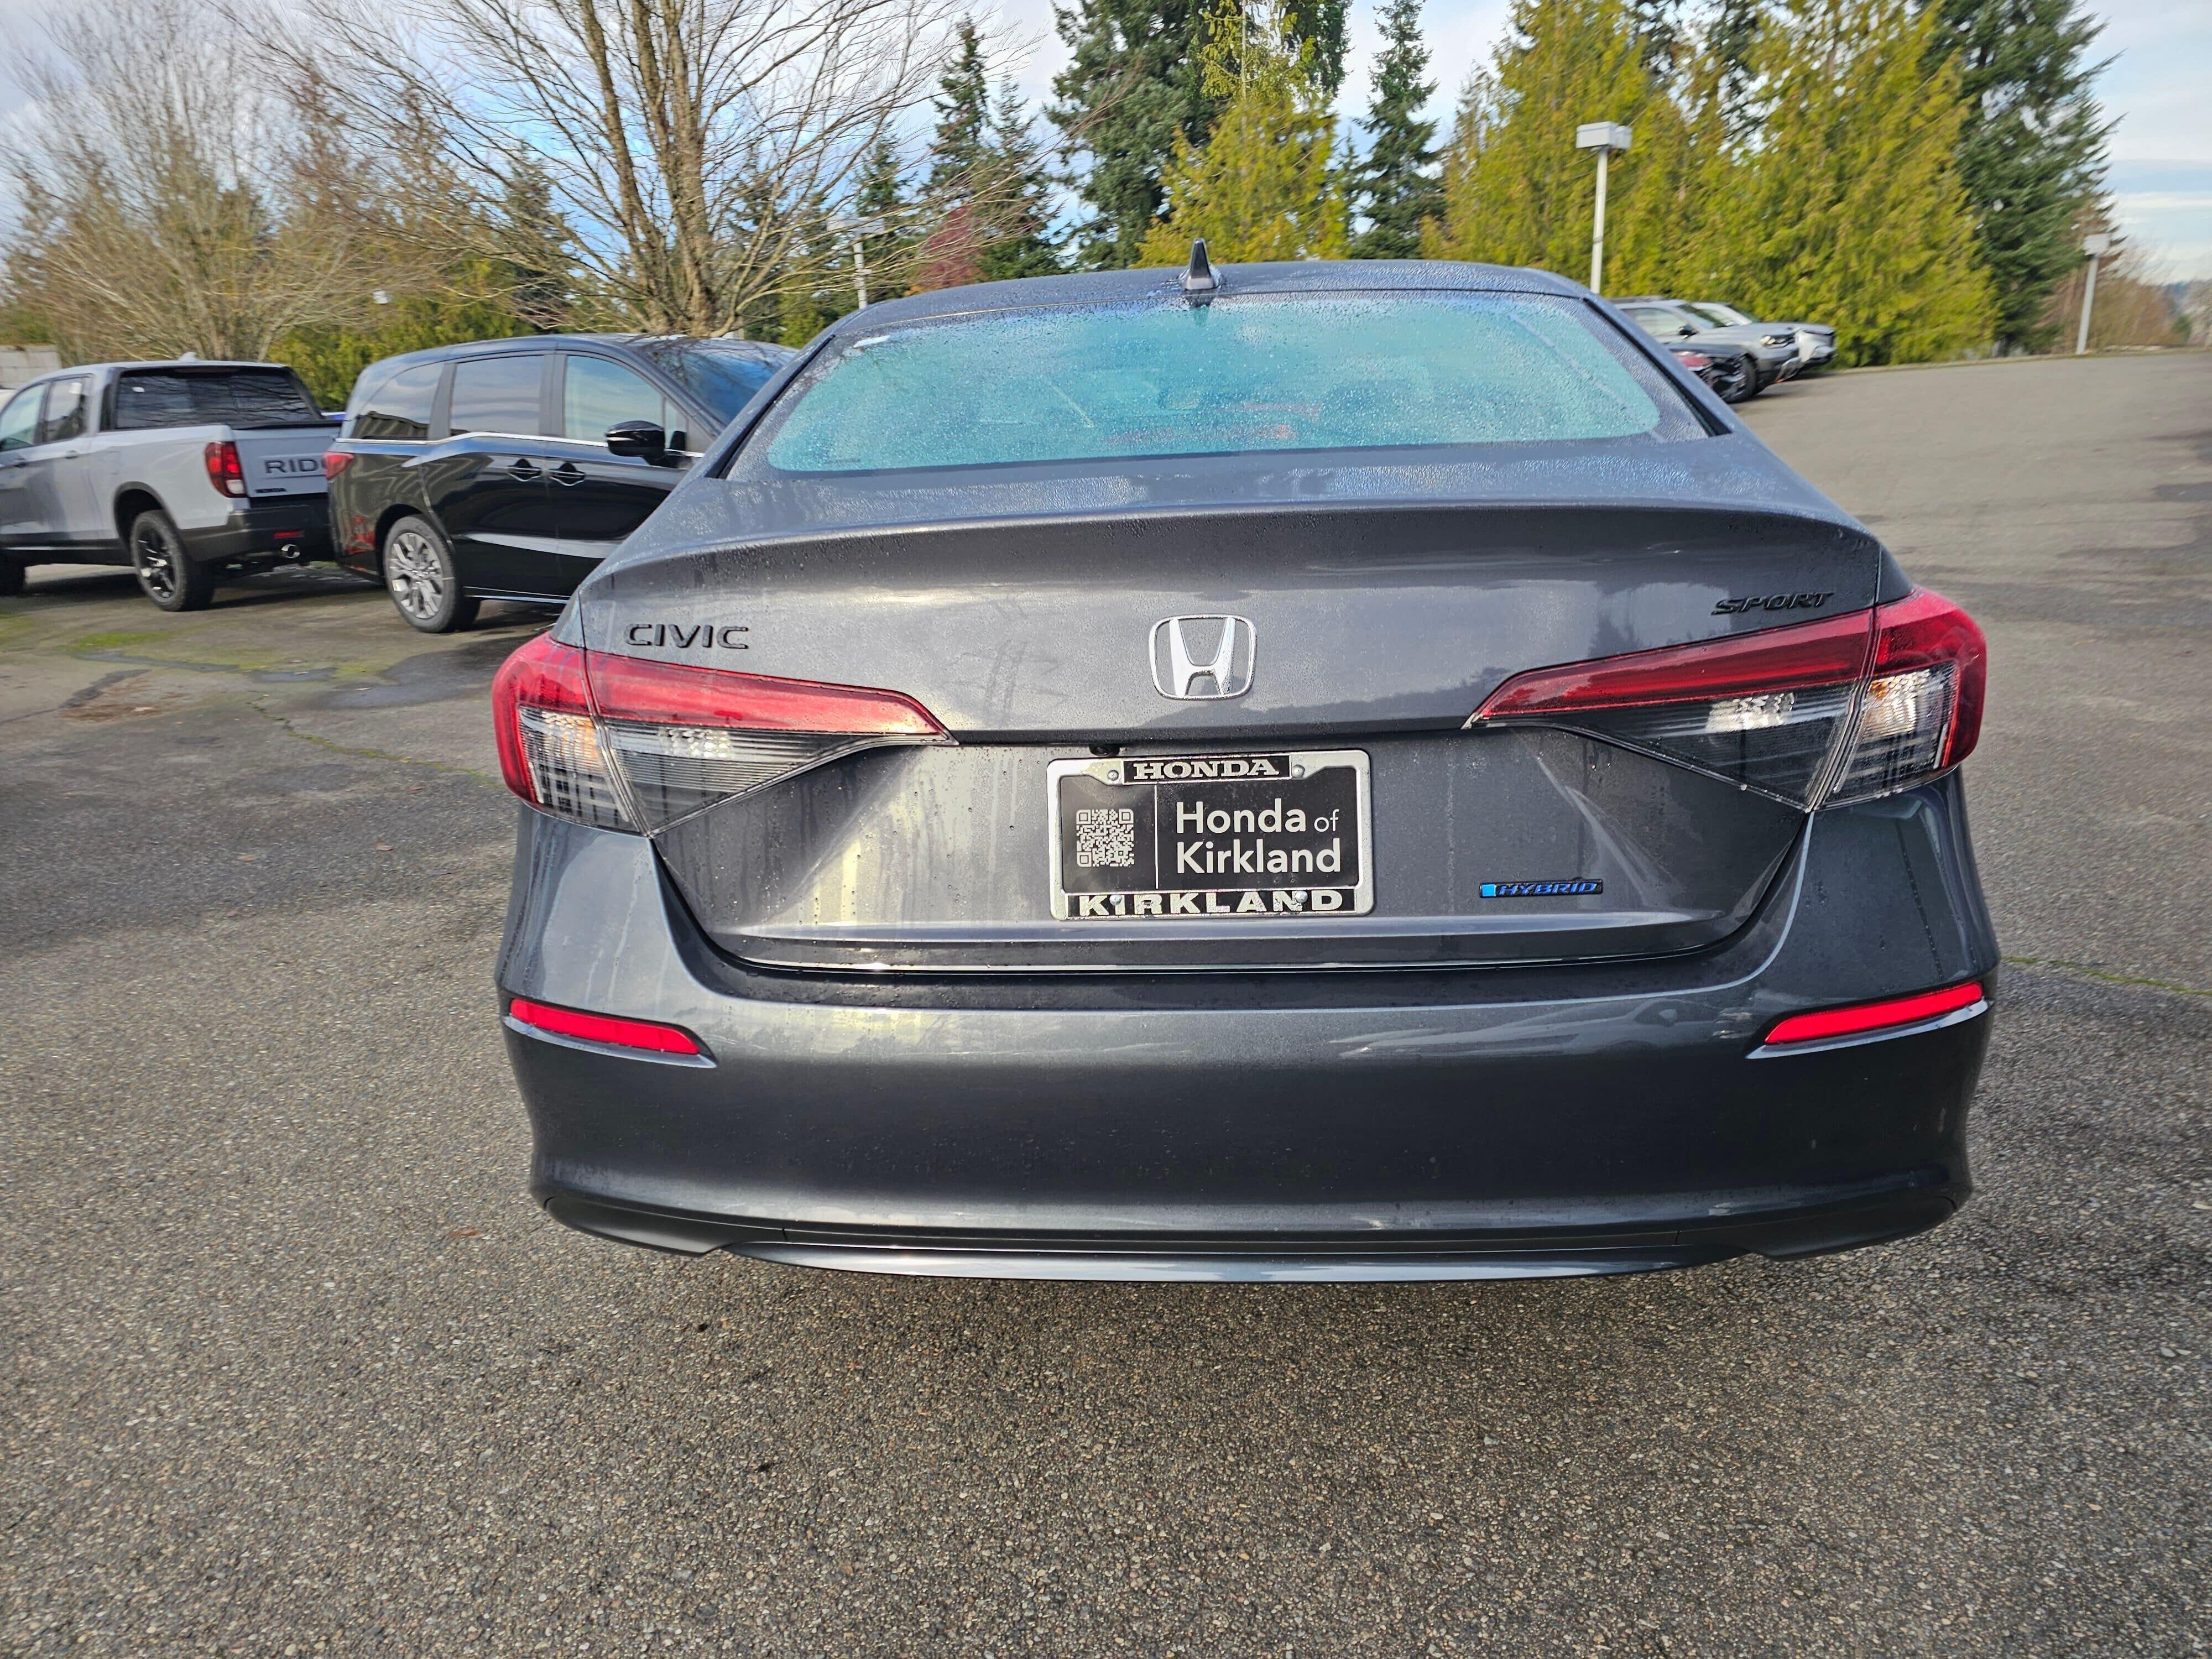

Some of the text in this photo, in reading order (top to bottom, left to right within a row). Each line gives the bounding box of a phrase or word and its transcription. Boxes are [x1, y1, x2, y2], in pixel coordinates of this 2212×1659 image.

[1711, 591, 1835, 615] SPORT
[623, 623, 749, 649] CIVIC
[1133, 759, 1280, 780] HONDA
[1176, 798, 1339, 833] Honda of
[1176, 838, 1340, 874] Kirkland
[1078, 889, 1343, 916] KIRKLAND
[1499, 883, 1597, 896] HYBRID
